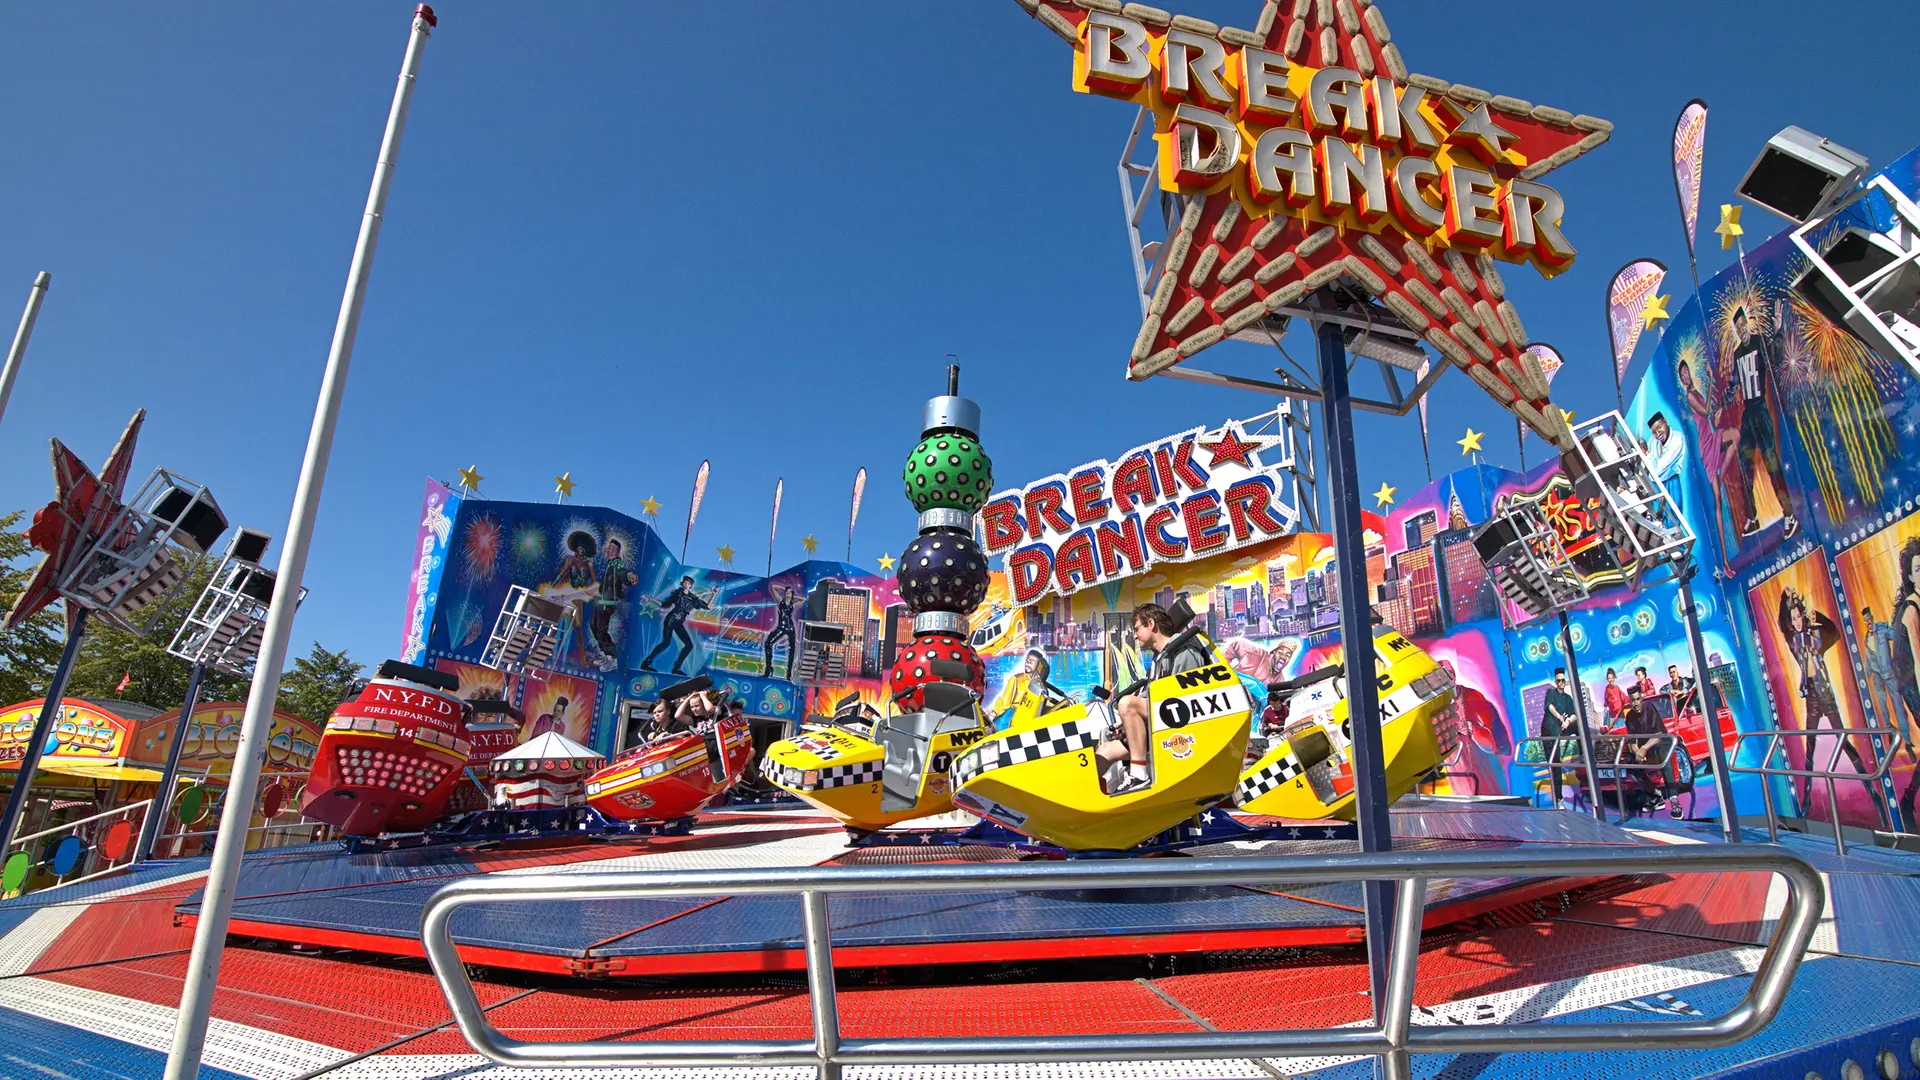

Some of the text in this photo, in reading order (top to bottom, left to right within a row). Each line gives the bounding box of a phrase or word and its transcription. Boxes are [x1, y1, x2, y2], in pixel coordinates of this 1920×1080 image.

[1083, 10, 1440, 158] BREAK
[1171, 103, 1577, 265] DANCER
[1612, 277, 1647, 305] BREAK
[1622, 272, 1662, 306] DANCER
[982, 436, 1209, 550] BREAK
[1009, 477, 1286, 602] DANCER
[411, 535, 435, 636] BREAK
[1388, 637, 1411, 651] NYC
[1176, 665, 1231, 689] NYC
[375, 688, 452, 715] N.Y.F.D
[1164, 692, 1232, 724] TAXI
[363, 705, 456, 731] FIRE DEPARTMENT
[0, 720, 114, 751] IG ONE
[399, 727, 413, 738] 14
[950, 730, 984, 746] NYC
[1162, 734, 1195, 748] Hard Rock
[268, 731, 319, 771] ON
[1078, 753, 1088, 767] 3
[702, 767, 710, 777] 13
[1296, 779, 1303, 788] 4
[871, 784, 878, 794] 2
